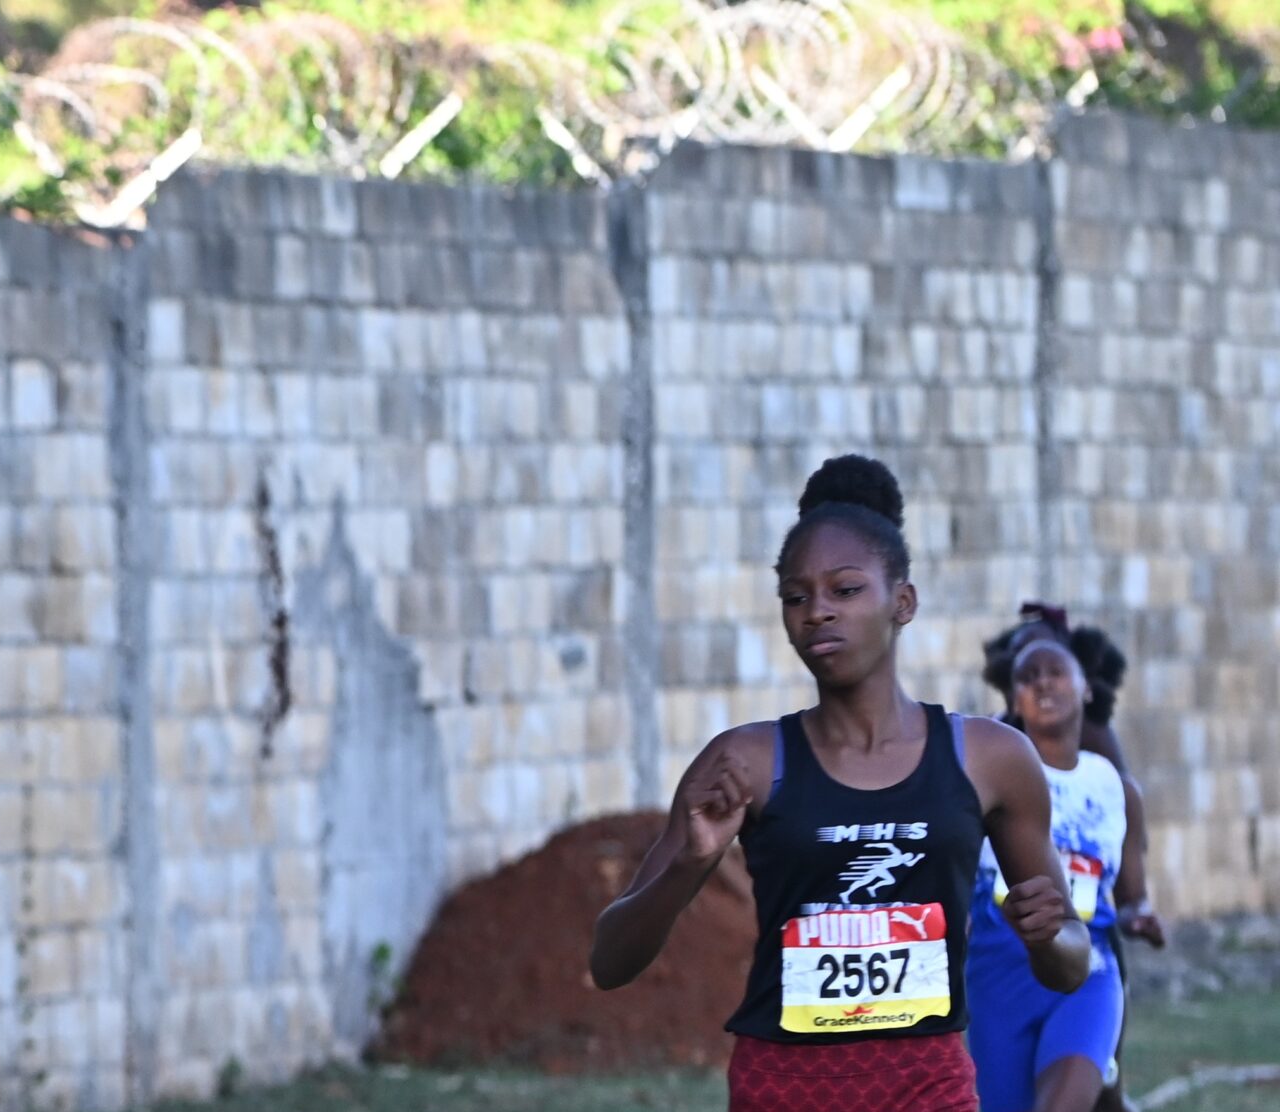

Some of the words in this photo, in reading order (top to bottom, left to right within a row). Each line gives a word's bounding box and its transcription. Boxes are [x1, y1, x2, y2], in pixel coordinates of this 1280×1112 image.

[799, 911, 890, 946] PUMA
[818, 948, 910, 998] 2567
[813, 1012, 915, 1027] GraceKennedy
